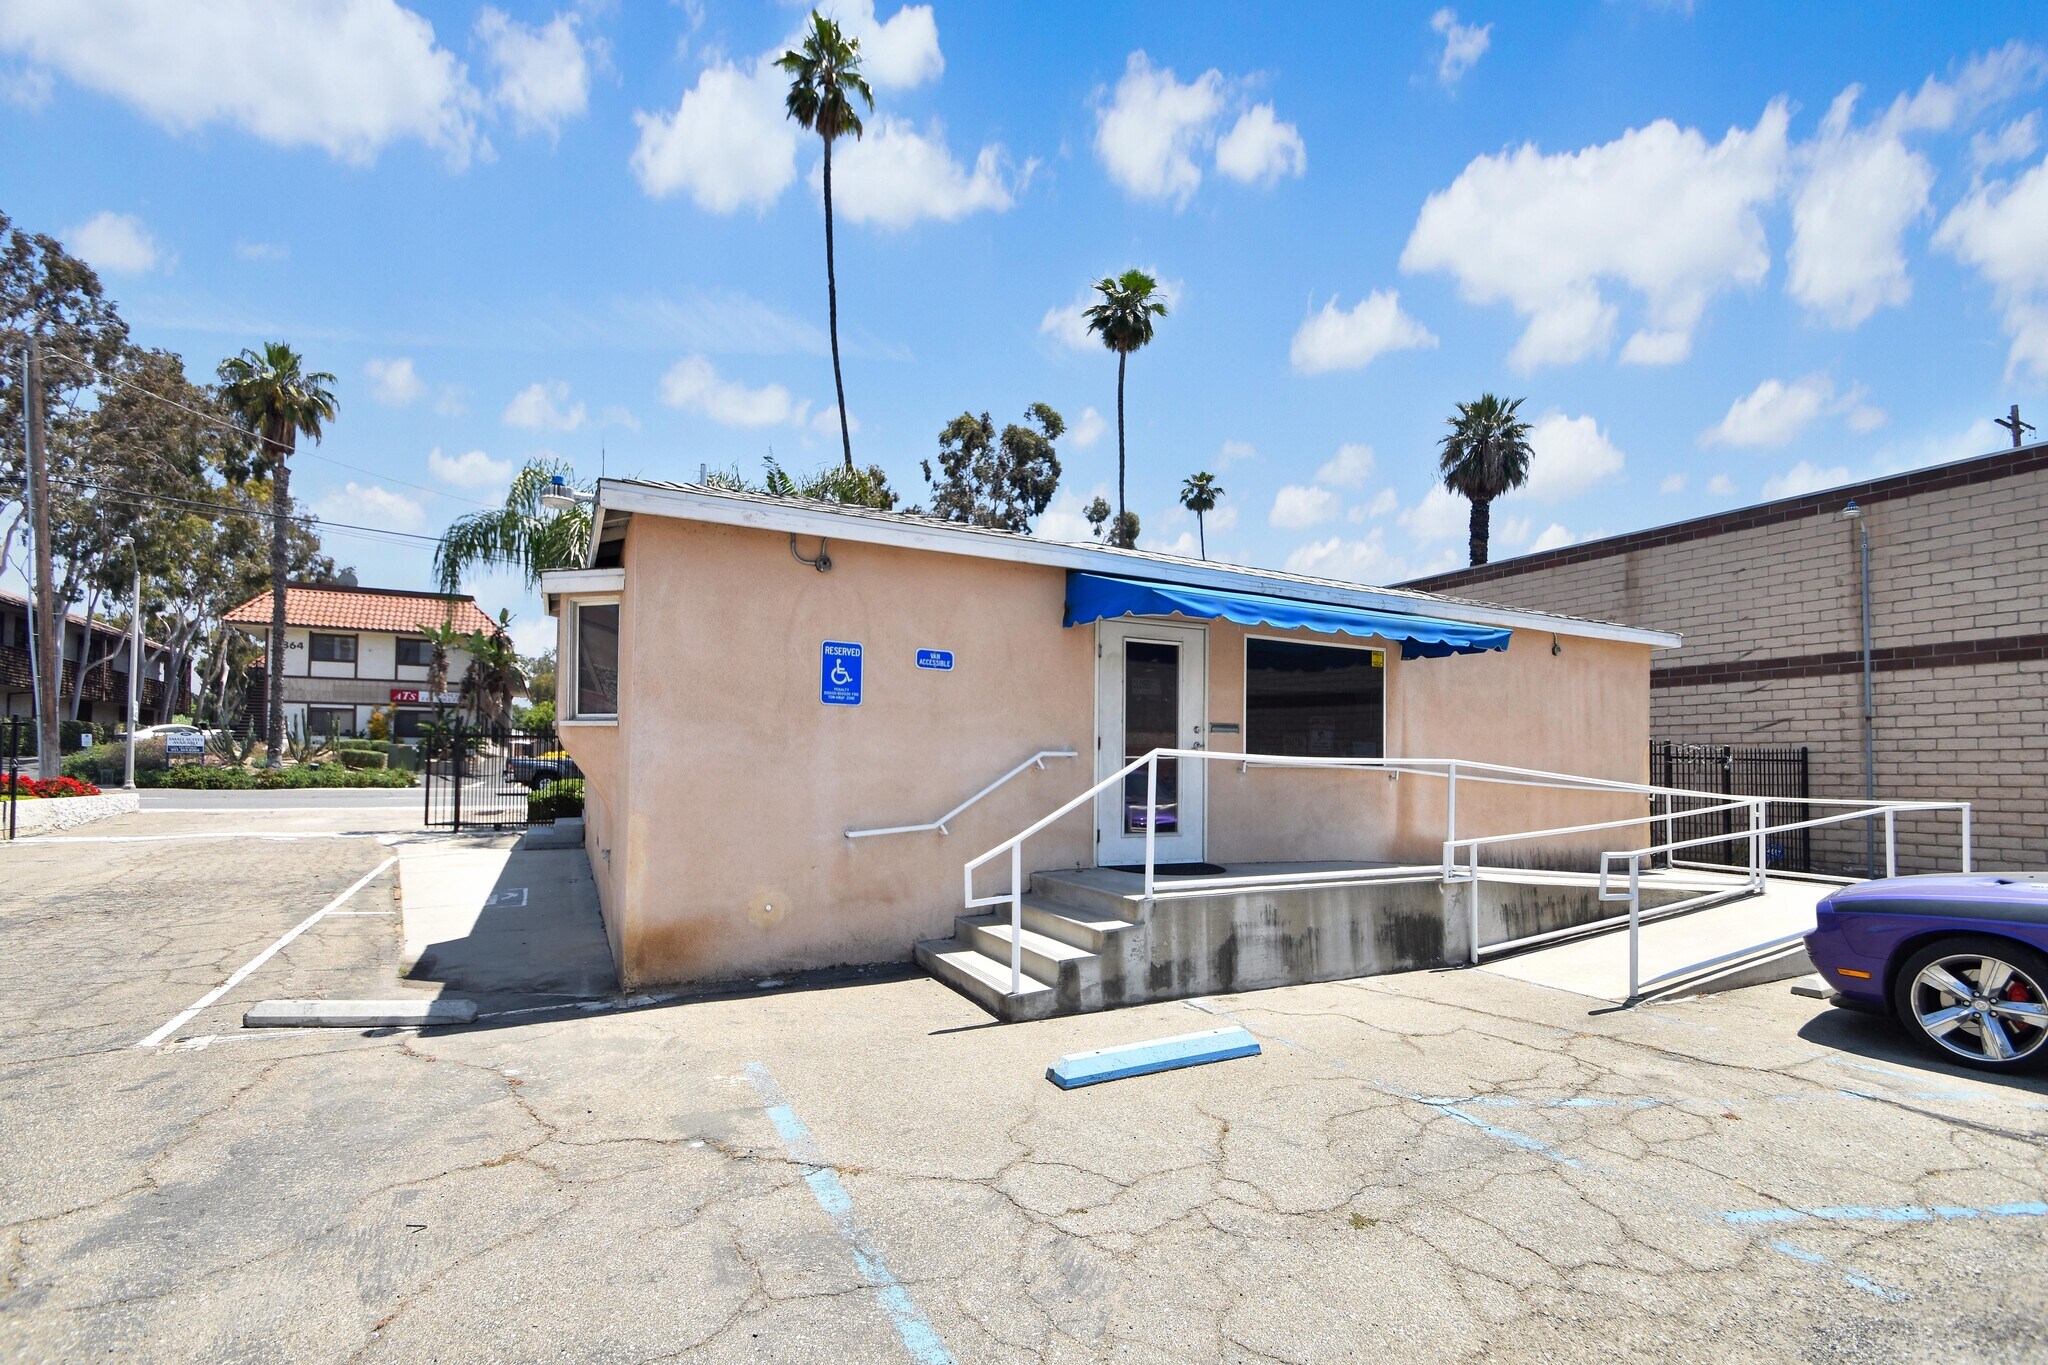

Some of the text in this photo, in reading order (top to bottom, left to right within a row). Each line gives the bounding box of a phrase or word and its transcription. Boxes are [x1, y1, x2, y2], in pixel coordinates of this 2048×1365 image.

[825, 646, 860, 656] RESERVED
[919, 658, 950, 667] ACCESSIBLE
[394, 691, 417, 701] ATS
